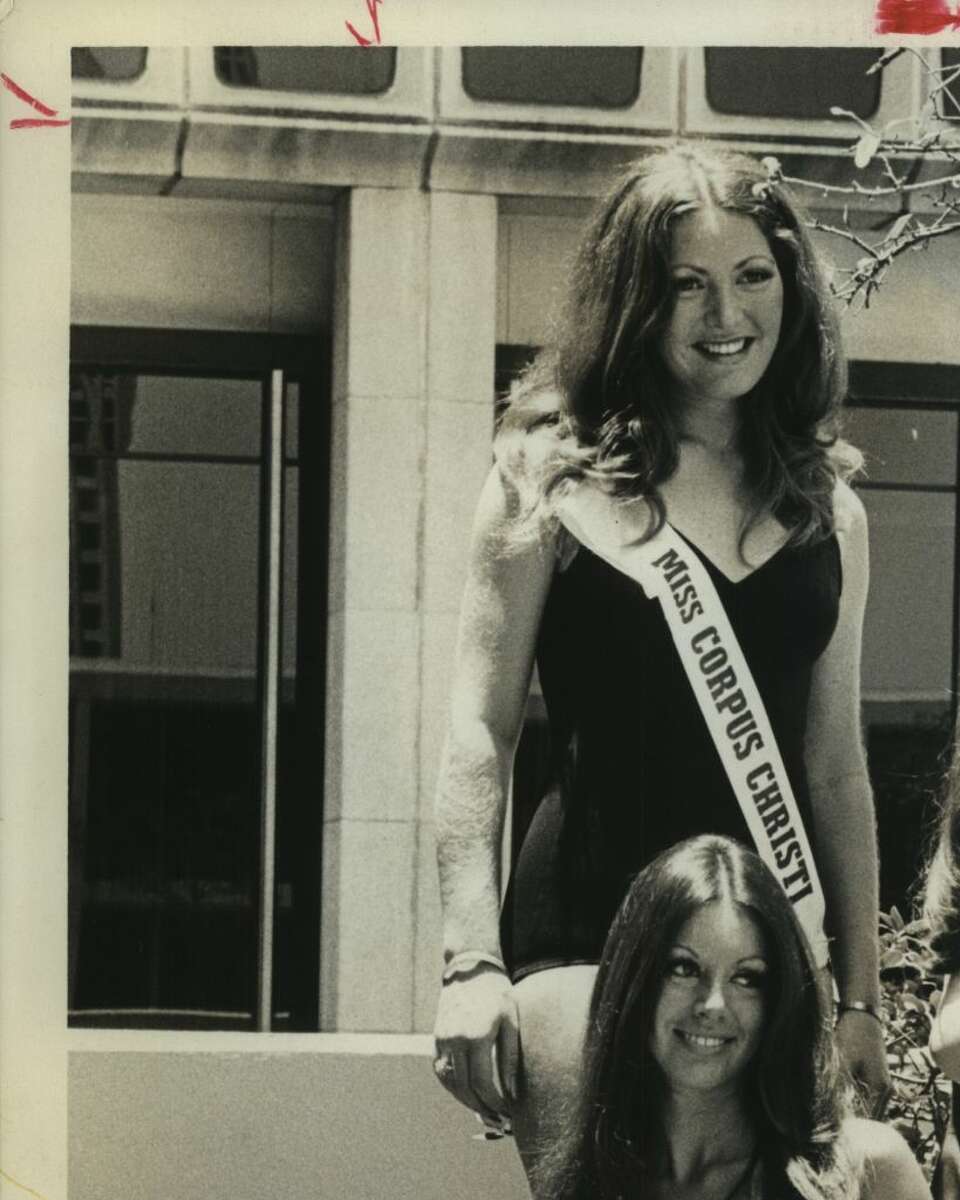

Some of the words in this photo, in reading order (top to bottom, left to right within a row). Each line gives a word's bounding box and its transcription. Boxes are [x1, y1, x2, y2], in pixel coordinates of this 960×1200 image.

[651, 548, 704, 625] MISS
[690, 625, 764, 761] CORPUS
[746, 761, 814, 905] CHRISTI
